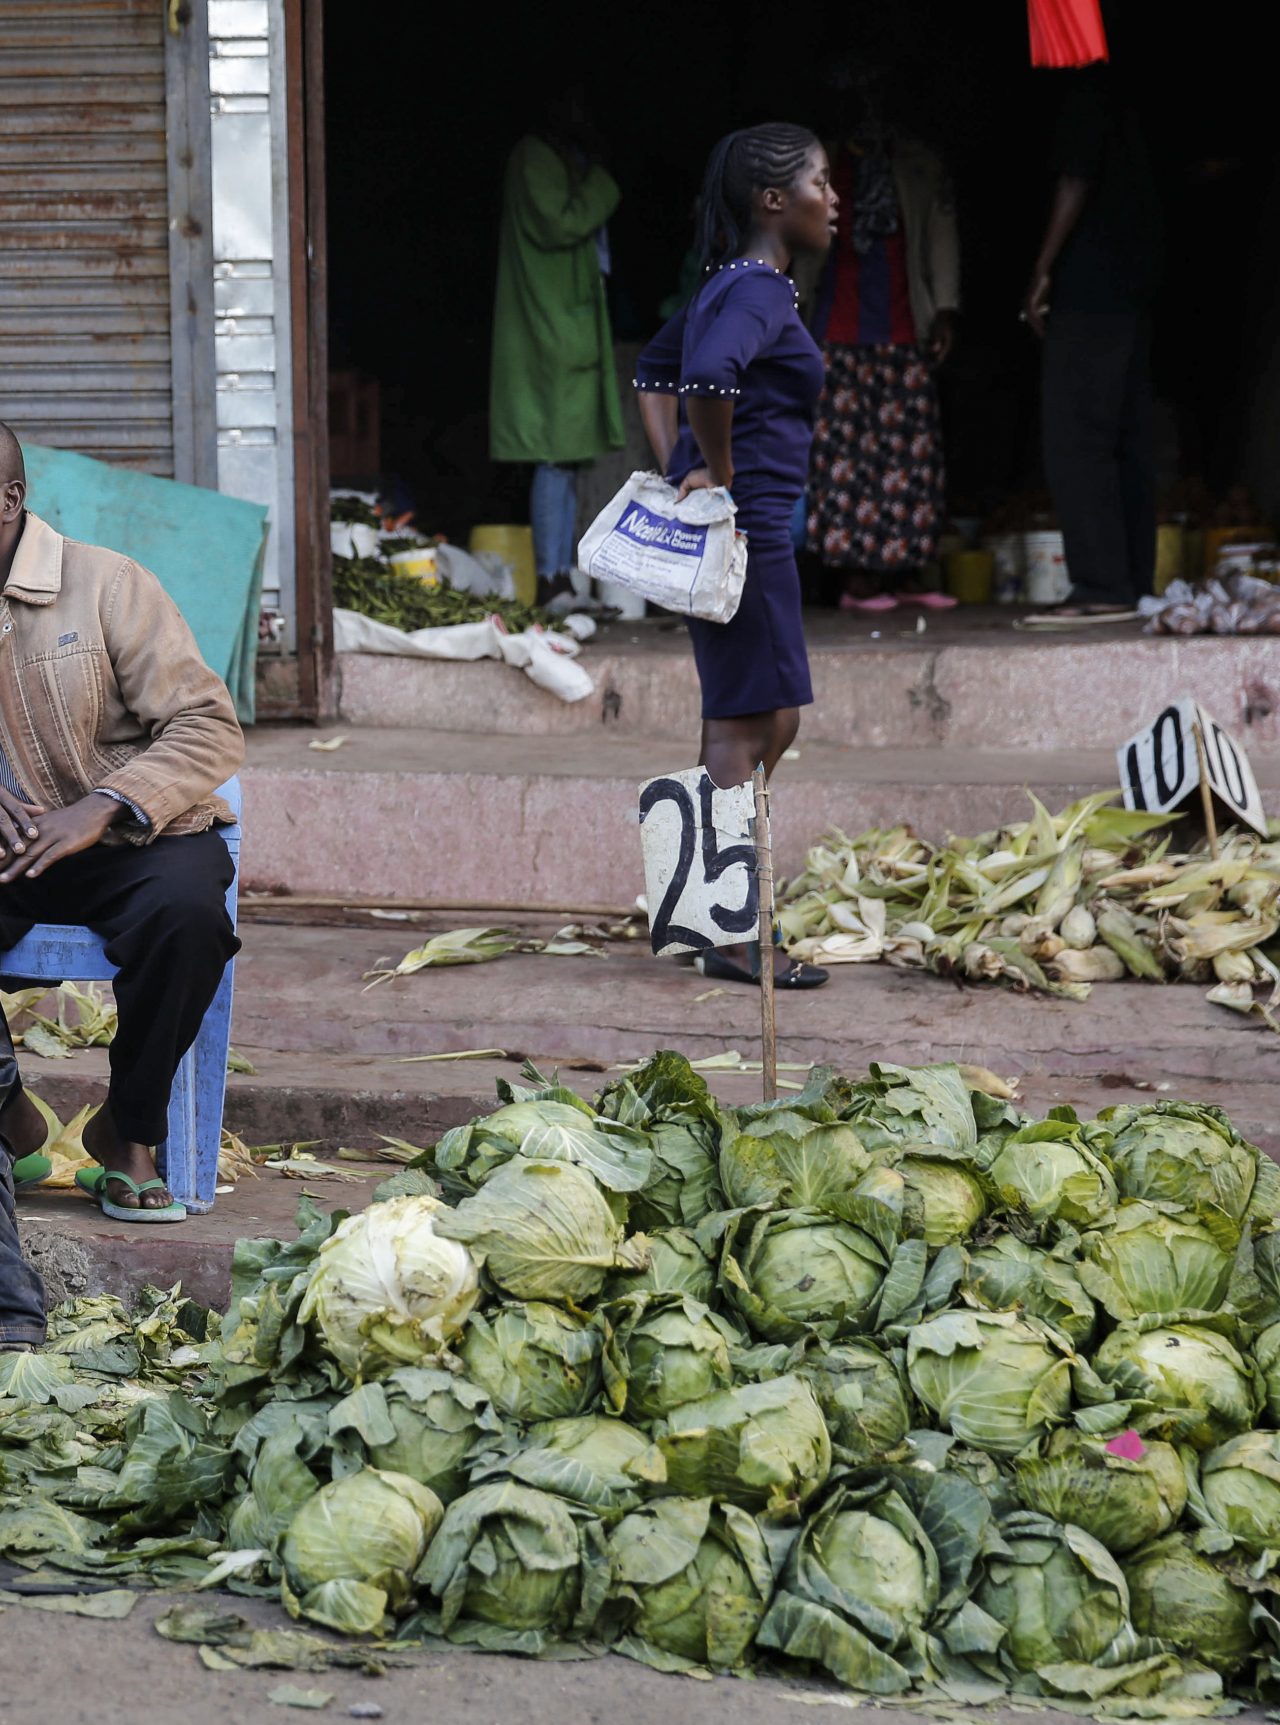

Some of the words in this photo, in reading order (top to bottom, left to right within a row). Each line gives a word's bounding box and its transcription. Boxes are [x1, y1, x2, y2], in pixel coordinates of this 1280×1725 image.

[671, 539, 698, 551] Clean
[674, 528, 703, 543] Power
[1126, 706, 1185, 811] 10
[1195, 704, 1248, 811] 10
[639, 773, 760, 957] 25
